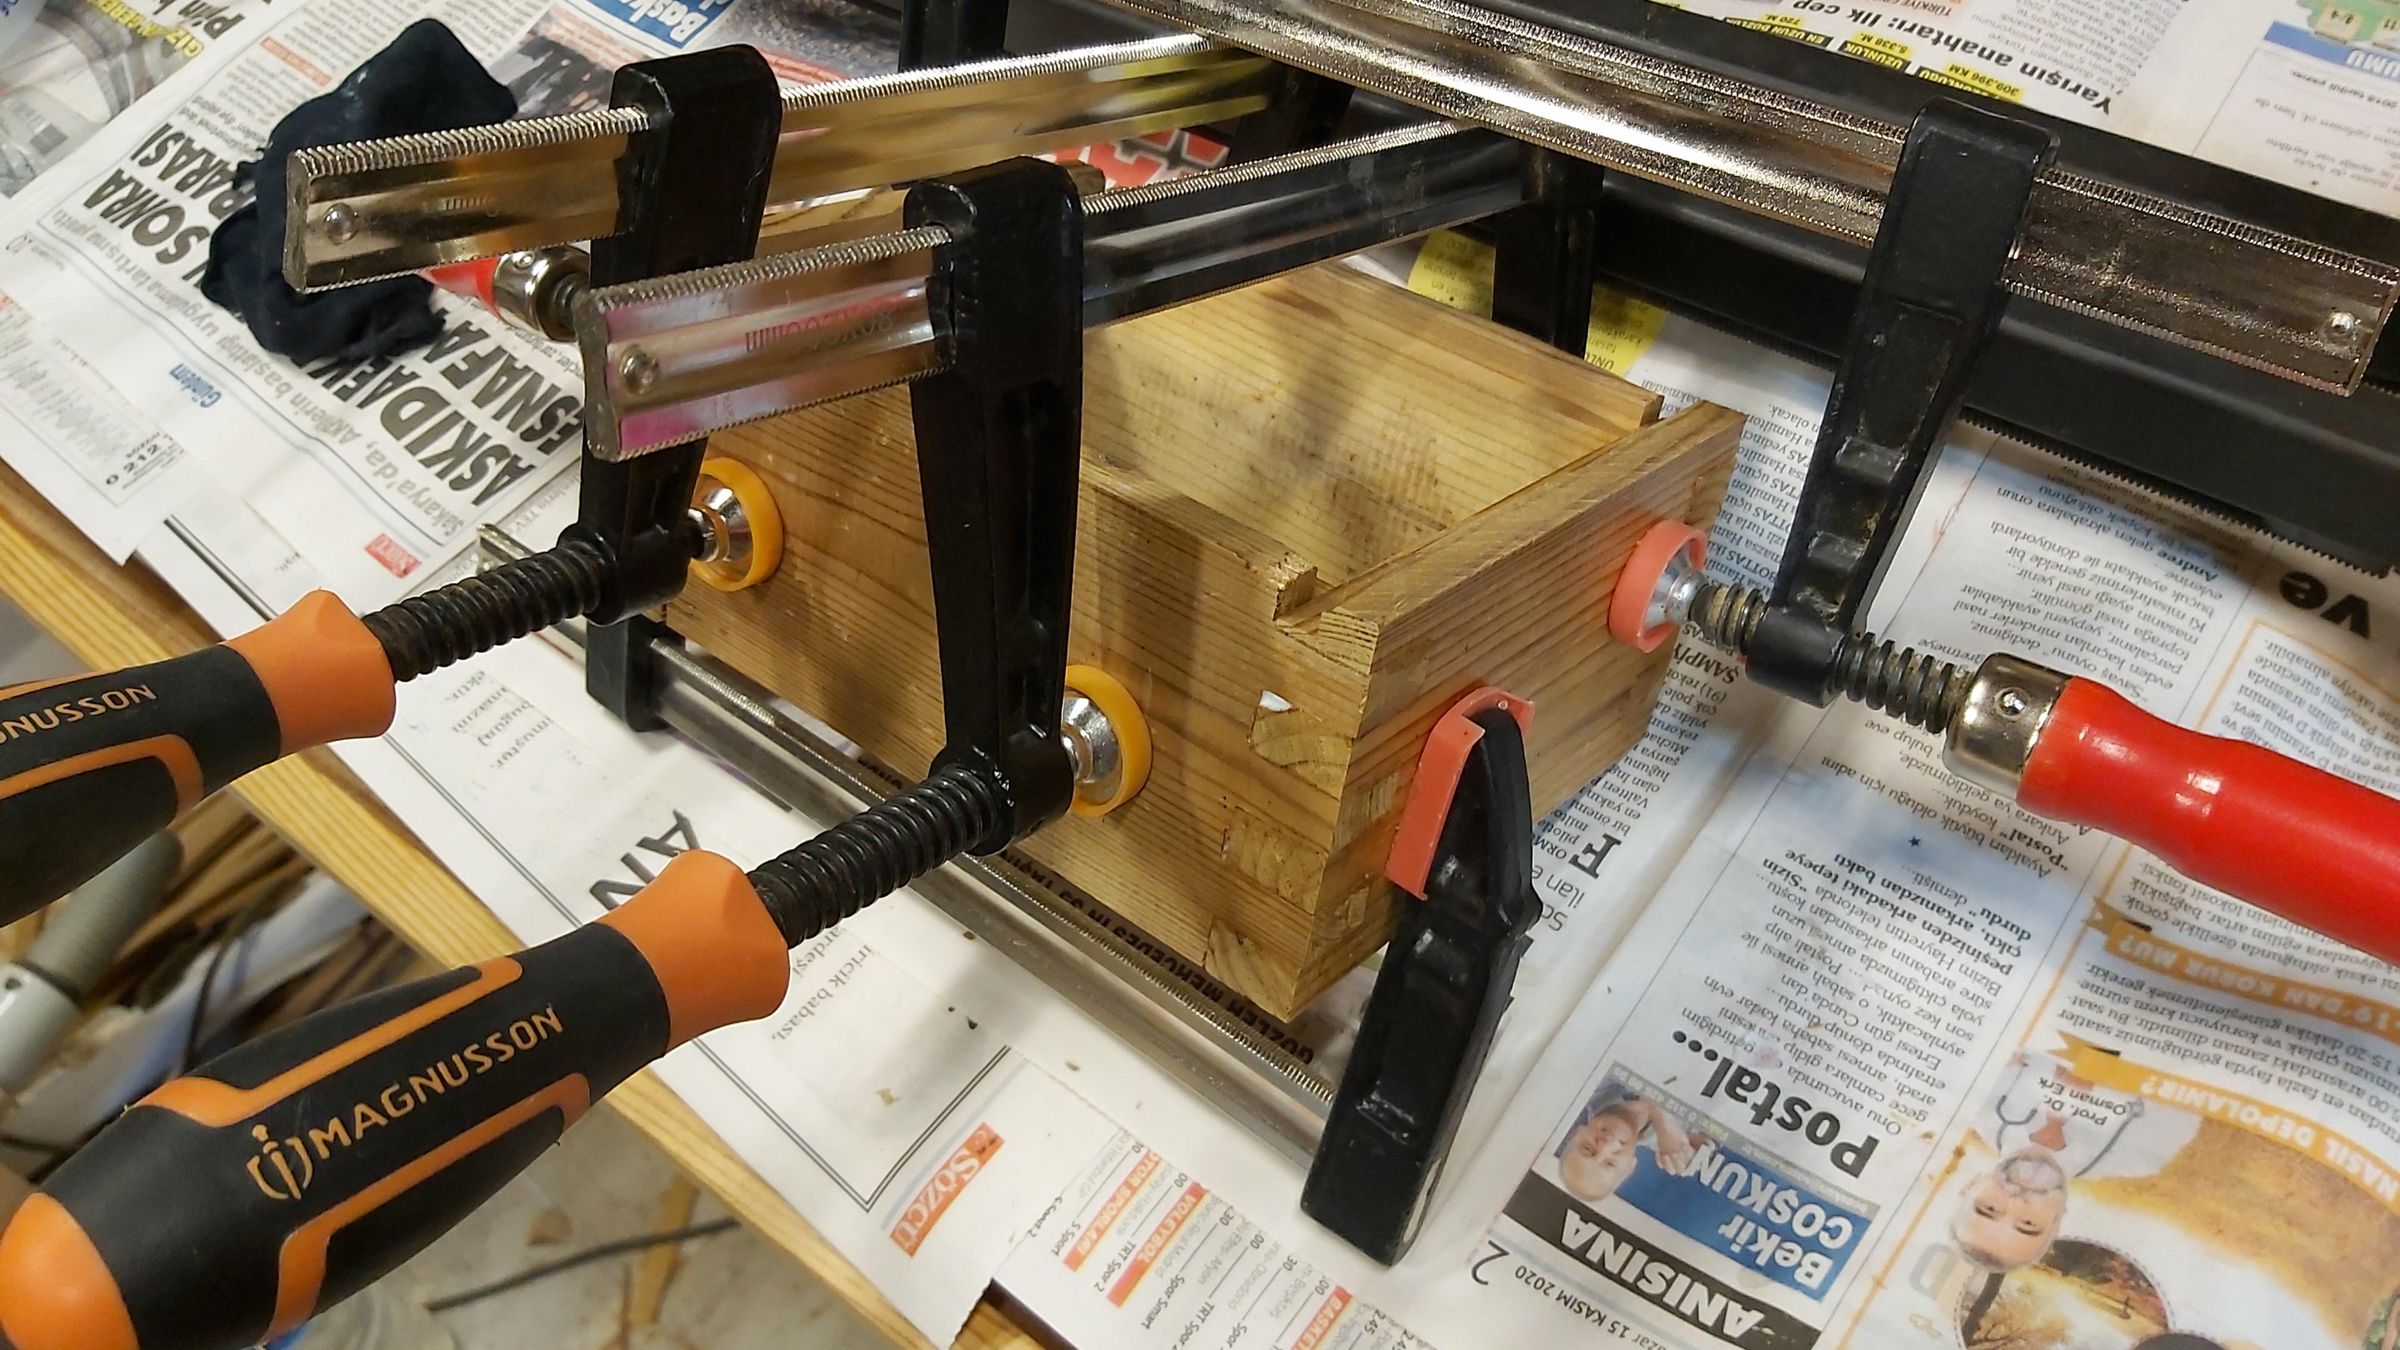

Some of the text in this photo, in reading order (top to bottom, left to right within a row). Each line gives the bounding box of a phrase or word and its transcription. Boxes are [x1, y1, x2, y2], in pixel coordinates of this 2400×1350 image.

[1805, 32, 1825, 45] EN
[1888, 17, 2012, 70] anahtarı:
[1842, 41, 1905, 70] UZUNLUK
[1948, 63, 1970, 78] KM
[2019, 62, 2112, 114] Yarışın
[81, 166, 212, 265] SONRA
[1767, 403, 1810, 429] olacak.
[356, 360, 535, 505] ASKIDA
[362, 440, 464, 538] Sakarya'da,
[1731, 478, 1790, 512] Hamilton
[1997, 487, 2033, 506] onun
[1734, 515, 1765, 538] turla
[2035, 501, 2112, 536] akrabalara
[2005, 545, 2026, 562] bir
[2029, 553, 2087, 580] genelde
[2157, 550, 2218, 583] Andree
[1961, 584, 2041, 616] ayakkabılar
[2273, 565, 2368, 640] ve
[2043, 611, 2102, 638] yepyeni
[2188, 615, 2207, 633] Ki
[1663, 686, 1716, 717] çok pole
[1699, 681, 1727, 703] (91)
[1863, 717, 1934, 758] bulup eve
[2220, 715, 2238, 730] ve
[1601, 780, 1649, 808] Valtteri
[1631, 775, 1660, 793] olan
[1585, 787, 1640, 820] en yakın
[1611, 819, 1630, 836] bir
[1544, 873, 1585, 909] ilan
[1832, 853, 2023, 959] çıktı, arkanızdan baktı
[1784, 850, 2013, 976] peşinizden arkadaki tepeye
[1814, 885, 1882, 930] telefonda
[1740, 931, 1760, 949] ile
[1763, 921, 1792, 944] alıp
[1808, 904, 1888, 953] arkasından
[1761, 942, 1809, 974] annesi
[1884, 921, 1955, 971] Hayrettin
[1890, 947, 1956, 992] arabanın
[1957, 962, 2003, 997] Bizim
[1780, 974, 1861, 1029] Cunda'dan
[1811, 970, 1855, 1002] sabah
[1958, 986, 1992, 1011] süre
[1855, 993, 1871, 1012] o
[1913, 1004, 1942, 1029] kez
[2107, 1006, 2131, 1026] Bu
[2132, 994, 2181, 1020] krem
[1861, 1017, 1894, 1047] gün
[1945, 1020, 1974, 1043] son
[2057, 1008, 2113, 1036] saatler
[2133, 1015, 2209, 1047] dilimidir.
[2176, 1000, 2259, 1044] koruyucu
[1702, 975, 1937, 1106] aradı, annesi sabaha kadar evin
[1895, 1039, 1941, 1070] Ertesi
[2211, 1037, 2270, 1065] zaman
[2260, 1031, 2284, 1054] ve
[311, 1005, 564, 1161] MAGNUSSON
[1782, 1041, 1928, 1124] gece camlara gidip
[2222, 1058, 2273, 1086] fayda
[1669, 1028, 1880, 1178] Postal...
[1786, 1065, 1864, 1113] avucumda
[2038, 1077, 2127, 1117] Osman Erk
[2275, 1075, 2318, 1103] fazla
[2316, 1092, 2345, 1117] en
[1865, 1108, 1902, 1136] Onu
[2042, 1095, 2108, 1126] Prof. Dr.
[2325, 1137, 2400, 1201] NASIL
[1680, 1139, 1857, 1253] COŞKUN
[1049, 1229, 1076, 1256] Sport
[1135, 1190, 1197, 1267] VOLEYBOL
[1117, 1240, 1136, 1262] TRT
[1466, 1237, 1510, 1287] 2
[1715, 1211, 1835, 1291] Bekir
[1093, 1281, 1104, 1292] 2
[1099, 1259, 1122, 1285] Spor
[1559, 1206, 1765, 1337] ANISINA
[1141, 1273, 1186, 1330] Spor Smart
[1195, 1301, 1214, 1324] TRT
[1513, 1264, 1630, 1338] 15 KASIM 2020
[1173, 1319, 1200, 1348] Spor
[1224, 1321, 1248, 1348] Spor
